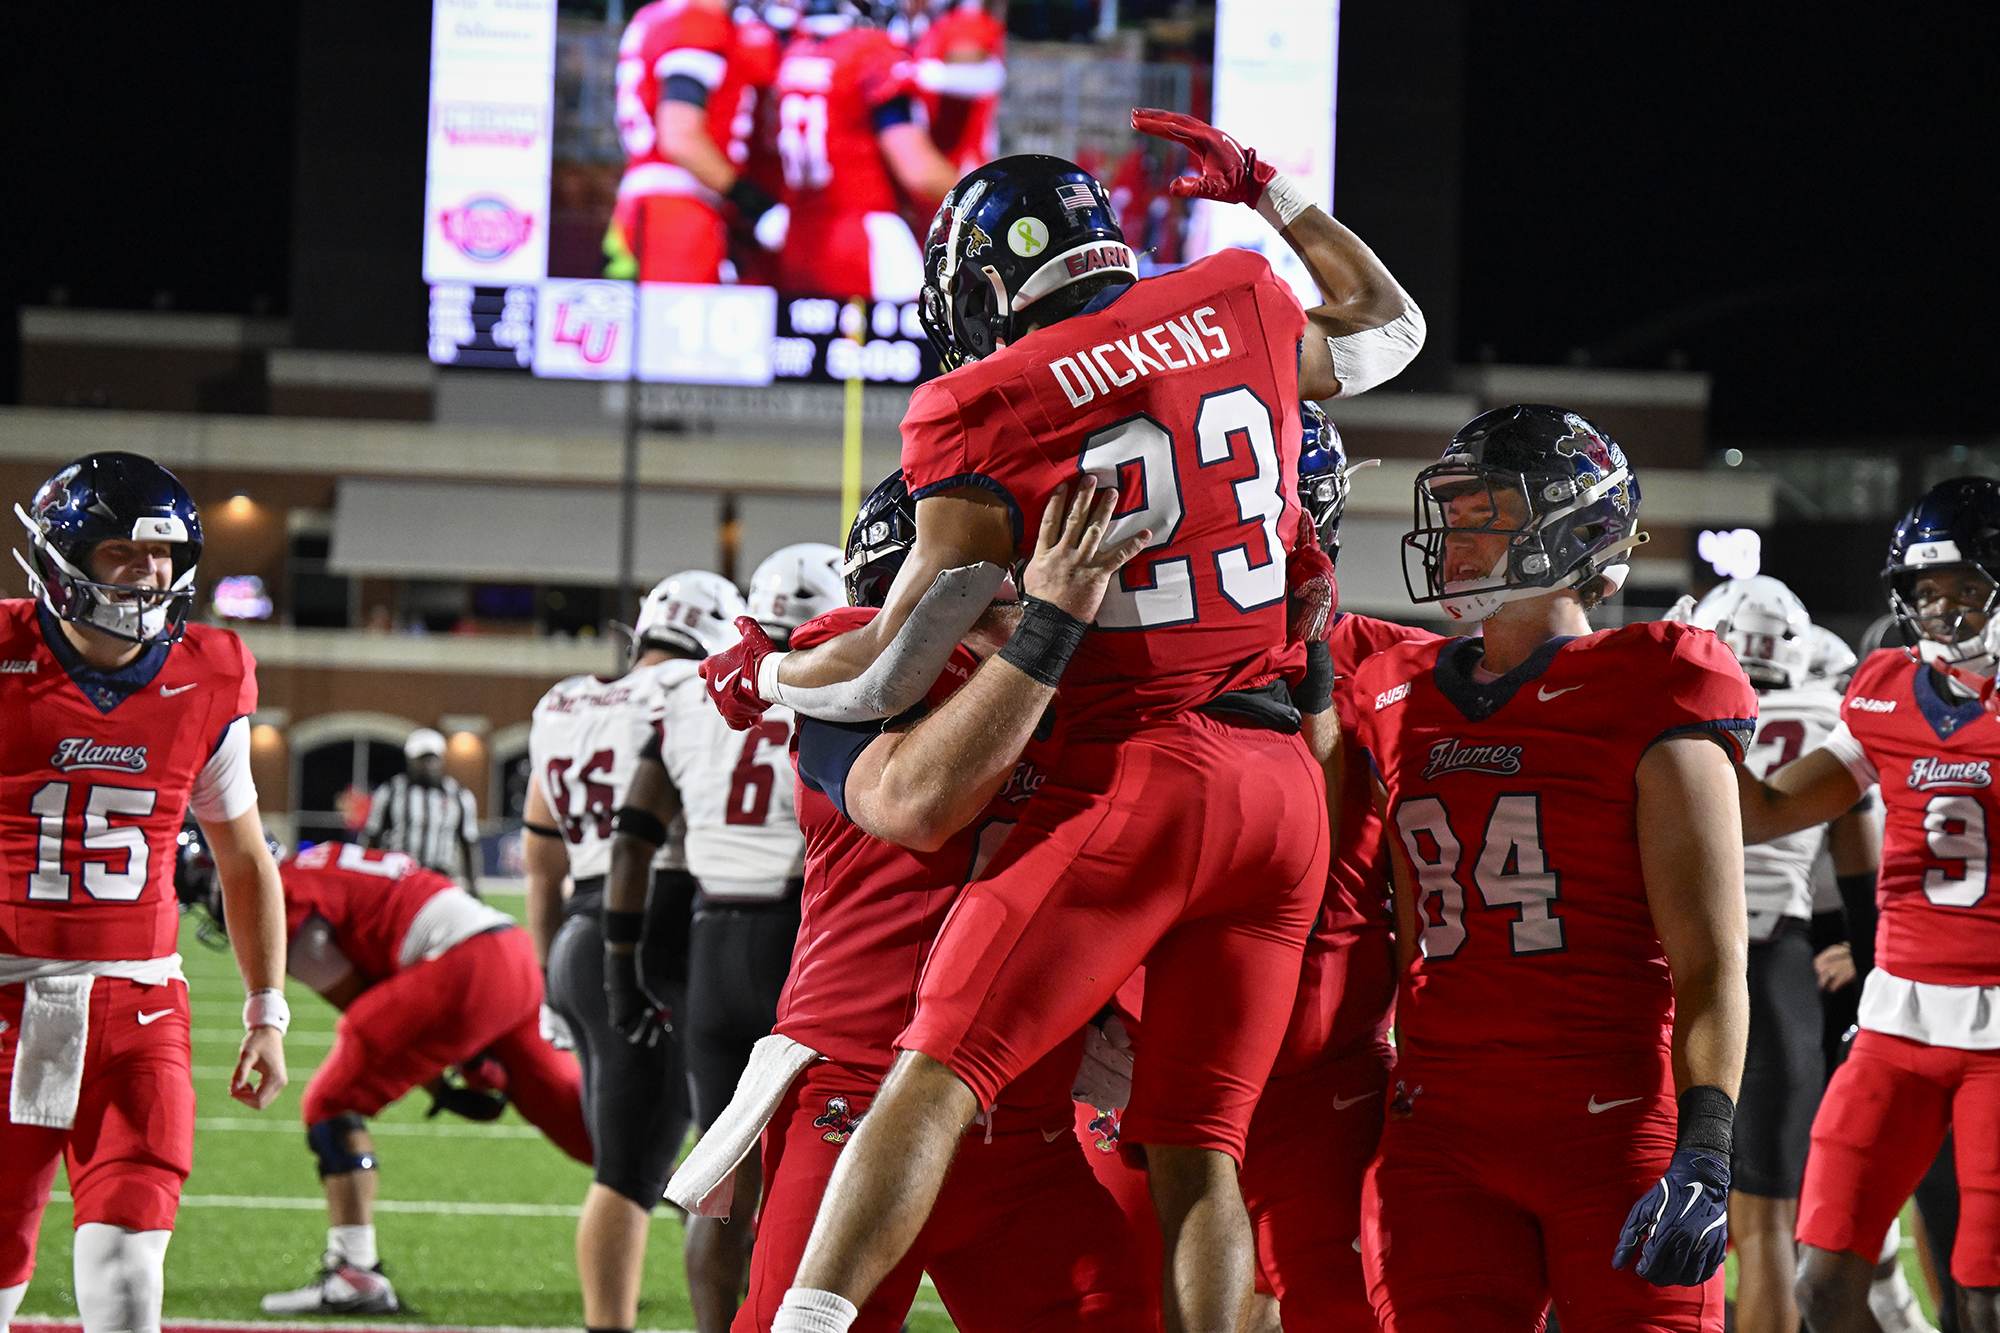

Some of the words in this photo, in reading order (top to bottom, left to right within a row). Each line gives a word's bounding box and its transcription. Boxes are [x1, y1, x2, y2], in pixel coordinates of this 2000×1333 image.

[1064, 246, 1131, 278] EARN
[555, 302, 619, 364] LU
[664, 293, 761, 356] 10
[1049, 305, 1231, 409] DICKENS
[1077, 383, 1288, 634] 23
[772, 593, 788, 617] 6
[50, 737, 148, 774] Flames
[725, 720, 790, 826] 6
[1420, 736, 1524, 781] Flames
[1906, 756, 1993, 792] Flames
[28, 780, 157, 901] 15
[1921, 793, 1988, 908] 9
[1396, 790, 1569, 962] 84
